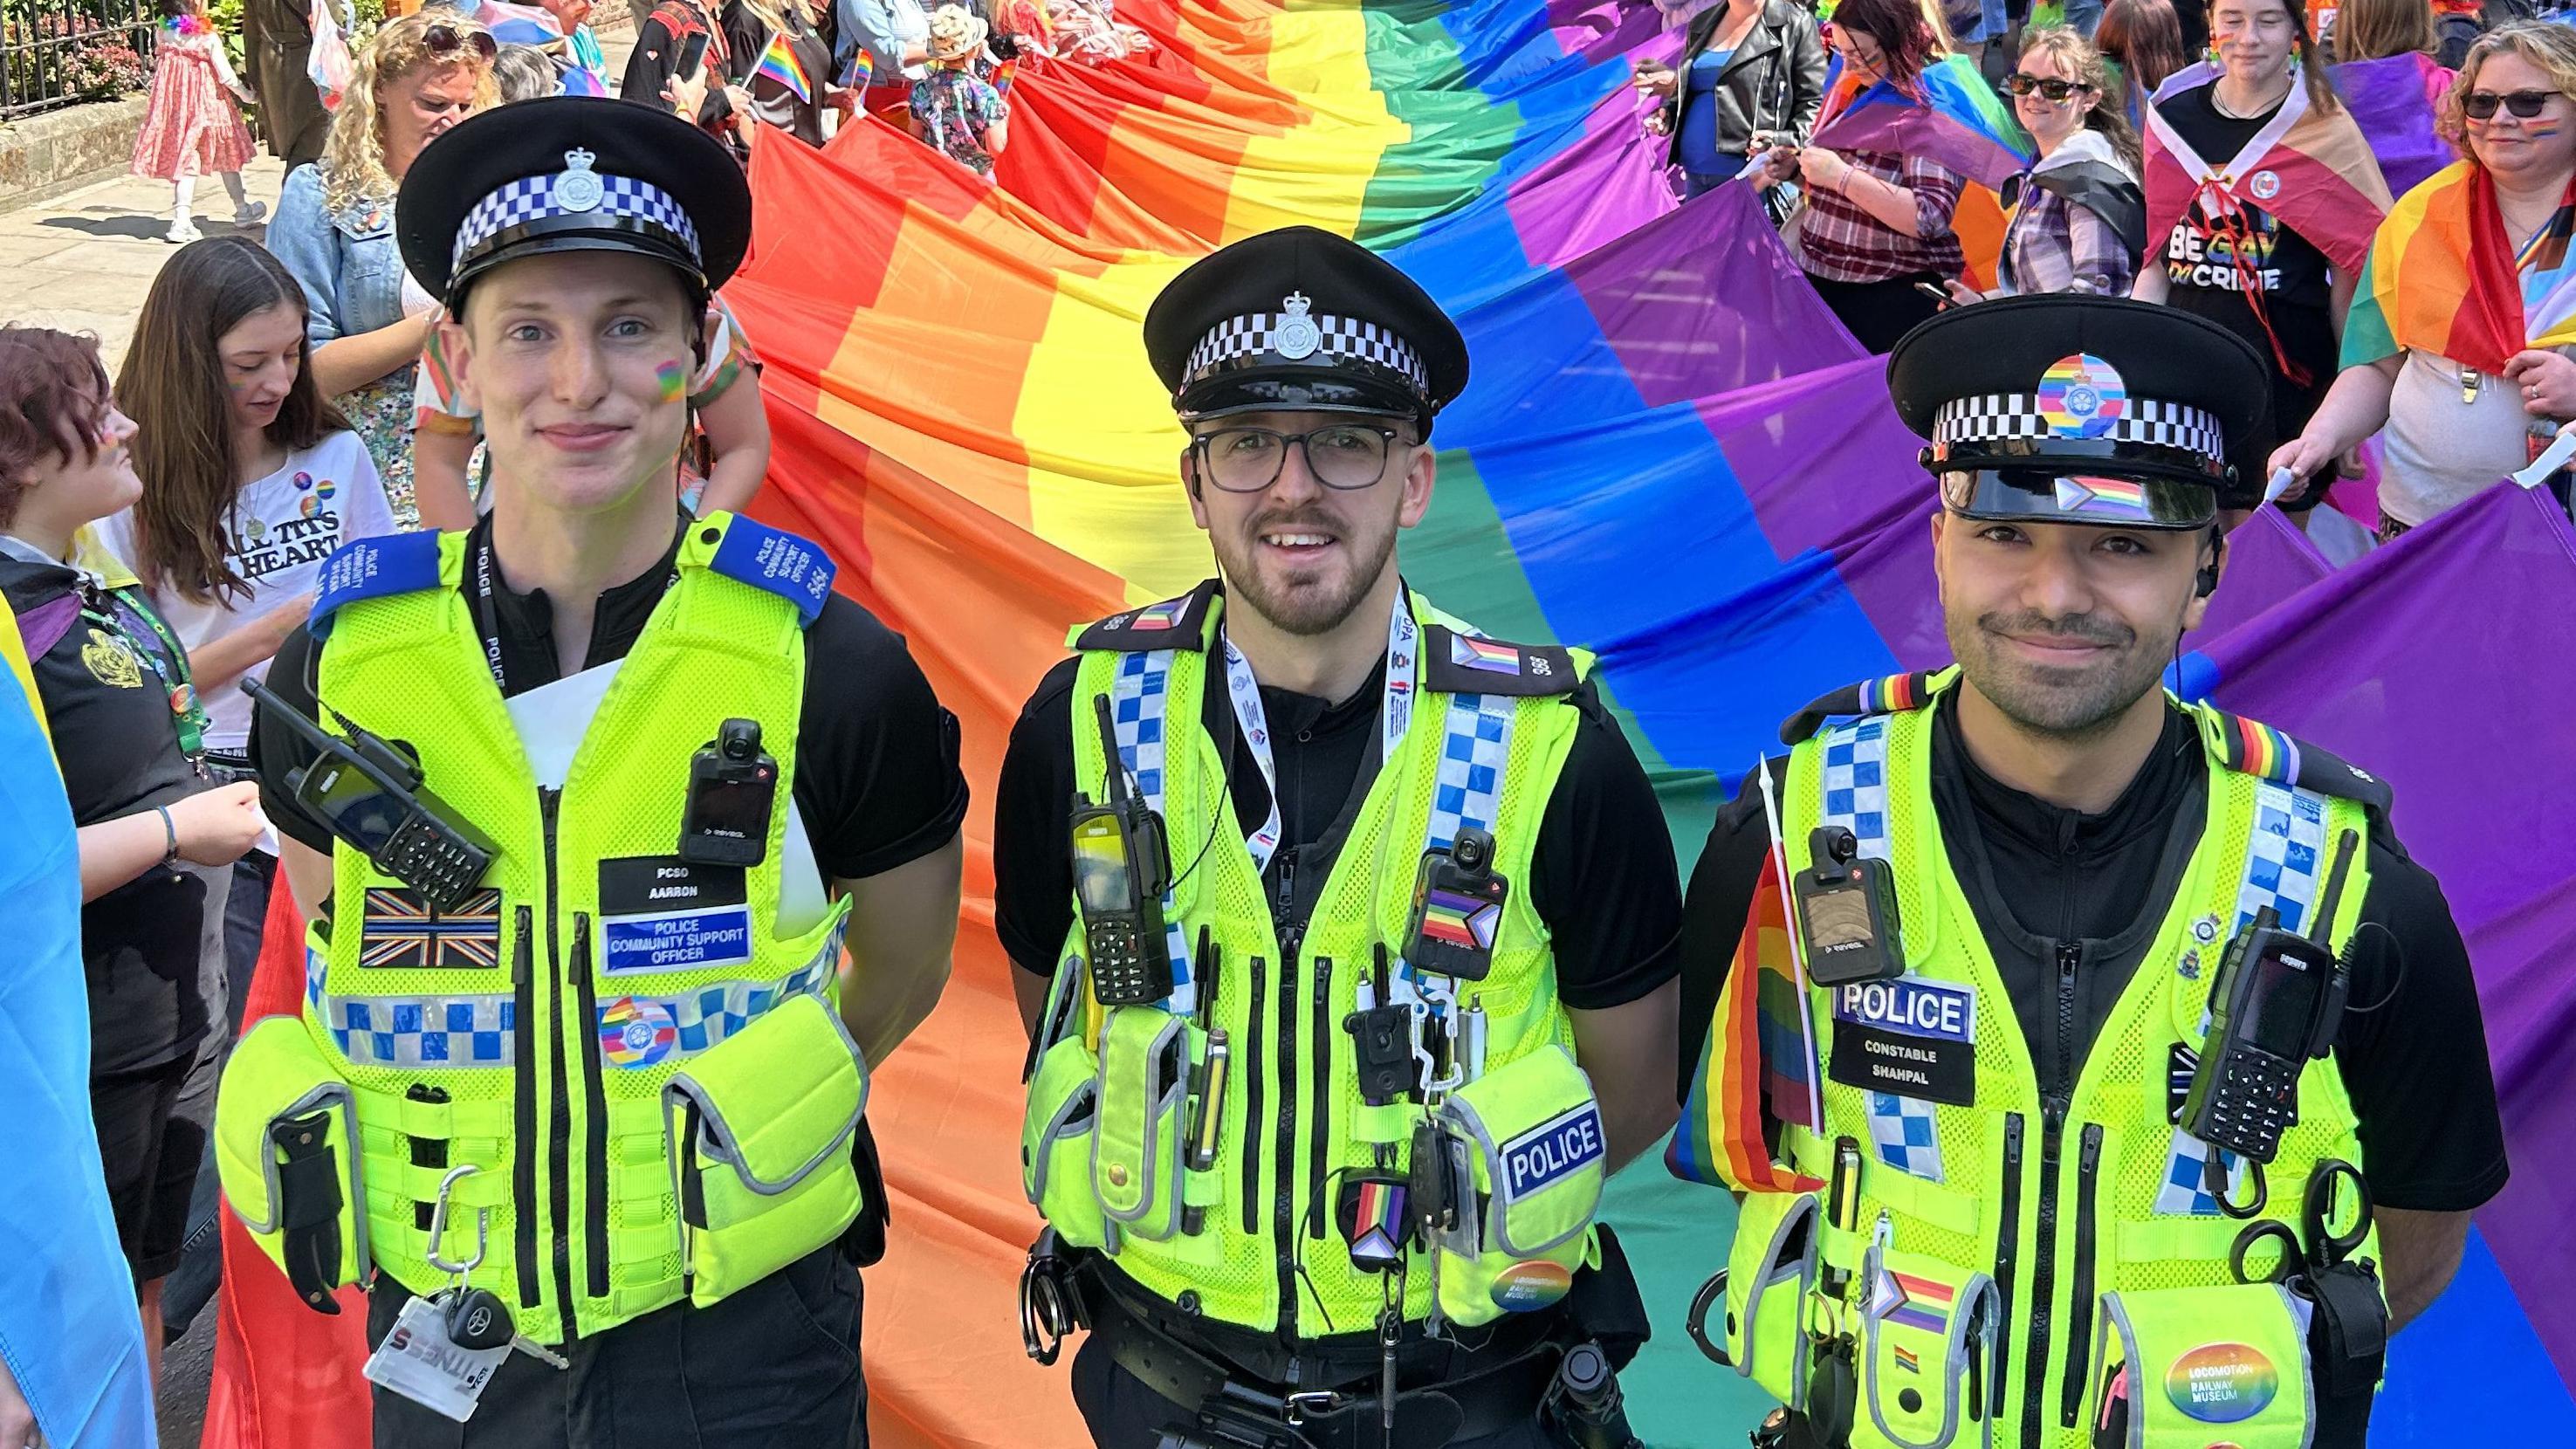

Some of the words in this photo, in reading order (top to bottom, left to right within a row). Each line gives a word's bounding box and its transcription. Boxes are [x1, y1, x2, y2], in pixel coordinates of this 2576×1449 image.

[2168, 225, 2203, 262] BE
[2207, 230, 2279, 266] GAY
[242, 535, 339, 578] HEART
[755, 537, 775, 564] POLICE
[763, 536, 789, 578] COMMUNITY
[778, 544, 800, 578] SUPPORT
[477, 546, 491, 597] POLICE
[790, 552, 811, 582] OFFICER
[656, 867, 689, 879] PCSO
[649, 886, 698, 899] AARRON
[656, 918, 699, 936] POLICE
[611, 935, 683, 953] COMMUNITY
[687, 928, 745, 946] SUPPORT
[651, 947, 704, 964] OFFICER
[1844, 984, 1961, 1034] POLICE
[1865, 1040, 1937, 1063] CONSTABLE
[1872, 1064, 1929, 1085] SHAHPAL
[1514, 1119, 1597, 1187] POLICE
[2189, 1363, 2253, 1379] LOCOMOTION
[2191, 1381, 2233, 1392] RAILWAY
[2192, 1390, 2237, 1403] MUSEUM
